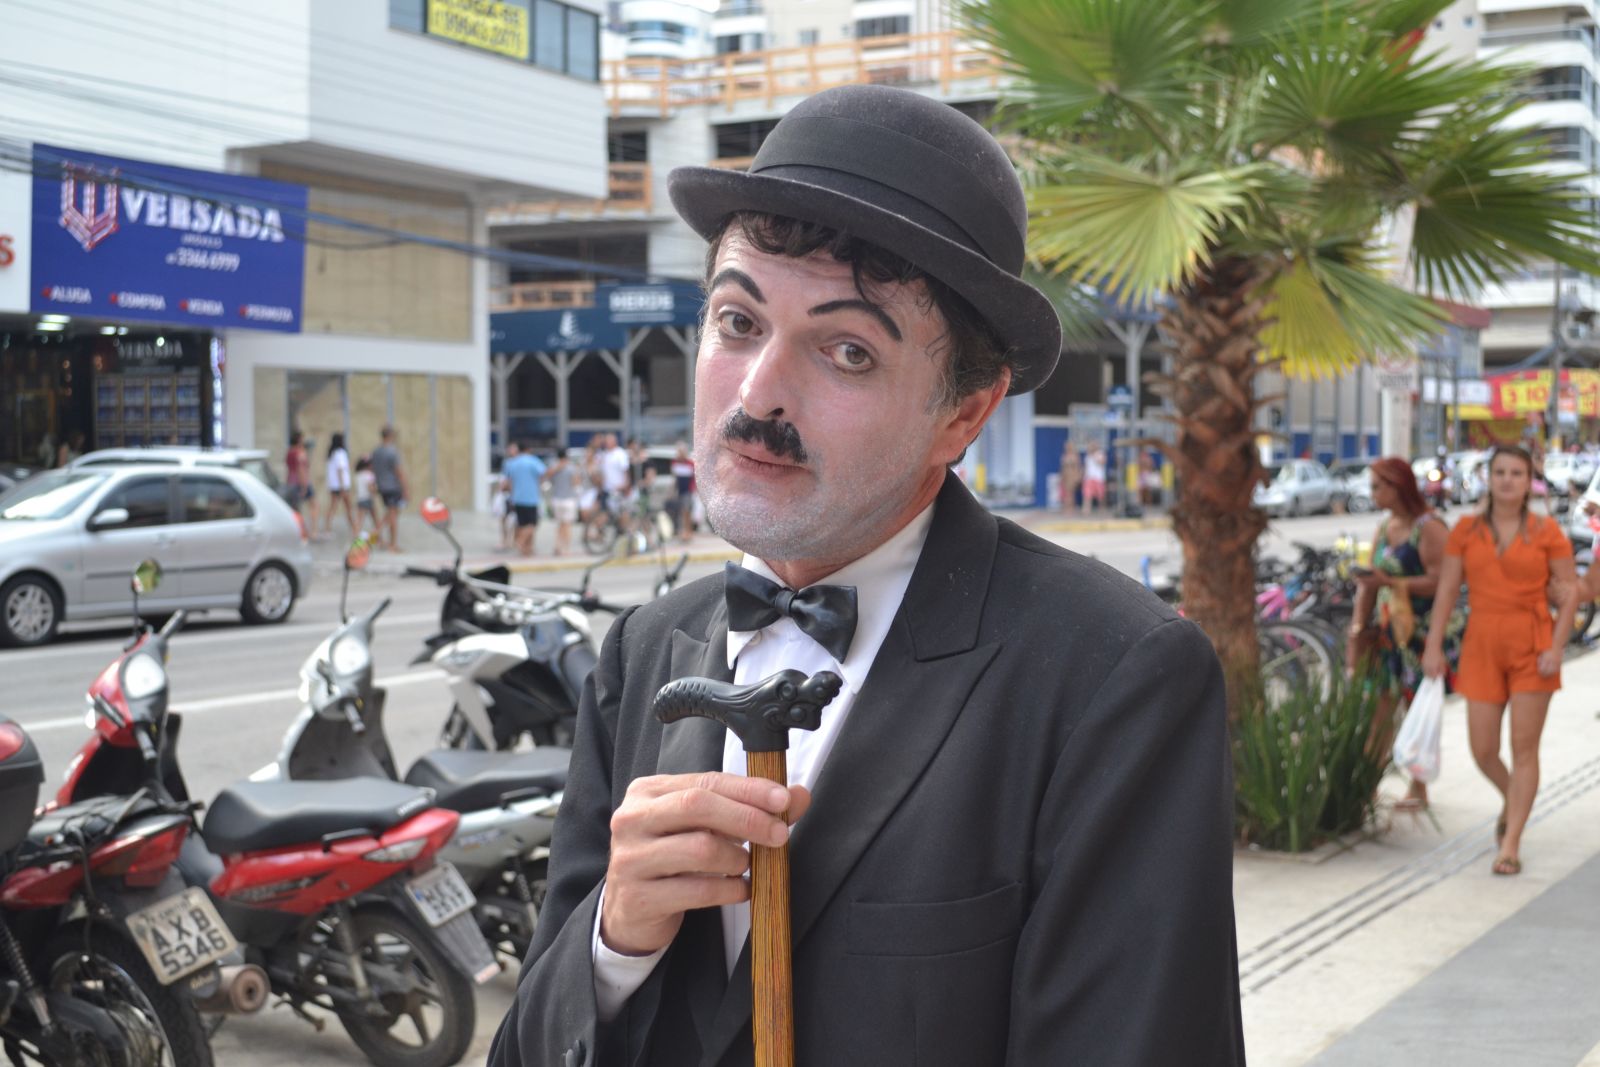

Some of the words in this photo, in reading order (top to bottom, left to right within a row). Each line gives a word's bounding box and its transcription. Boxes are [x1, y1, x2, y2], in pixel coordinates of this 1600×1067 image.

[121, 186, 286, 242] VERSADA
[118, 291, 166, 312] COMPRA
[187, 298, 224, 317] VENDA
[151, 907, 211, 952] AXB
[160, 928, 228, 977] 5346
